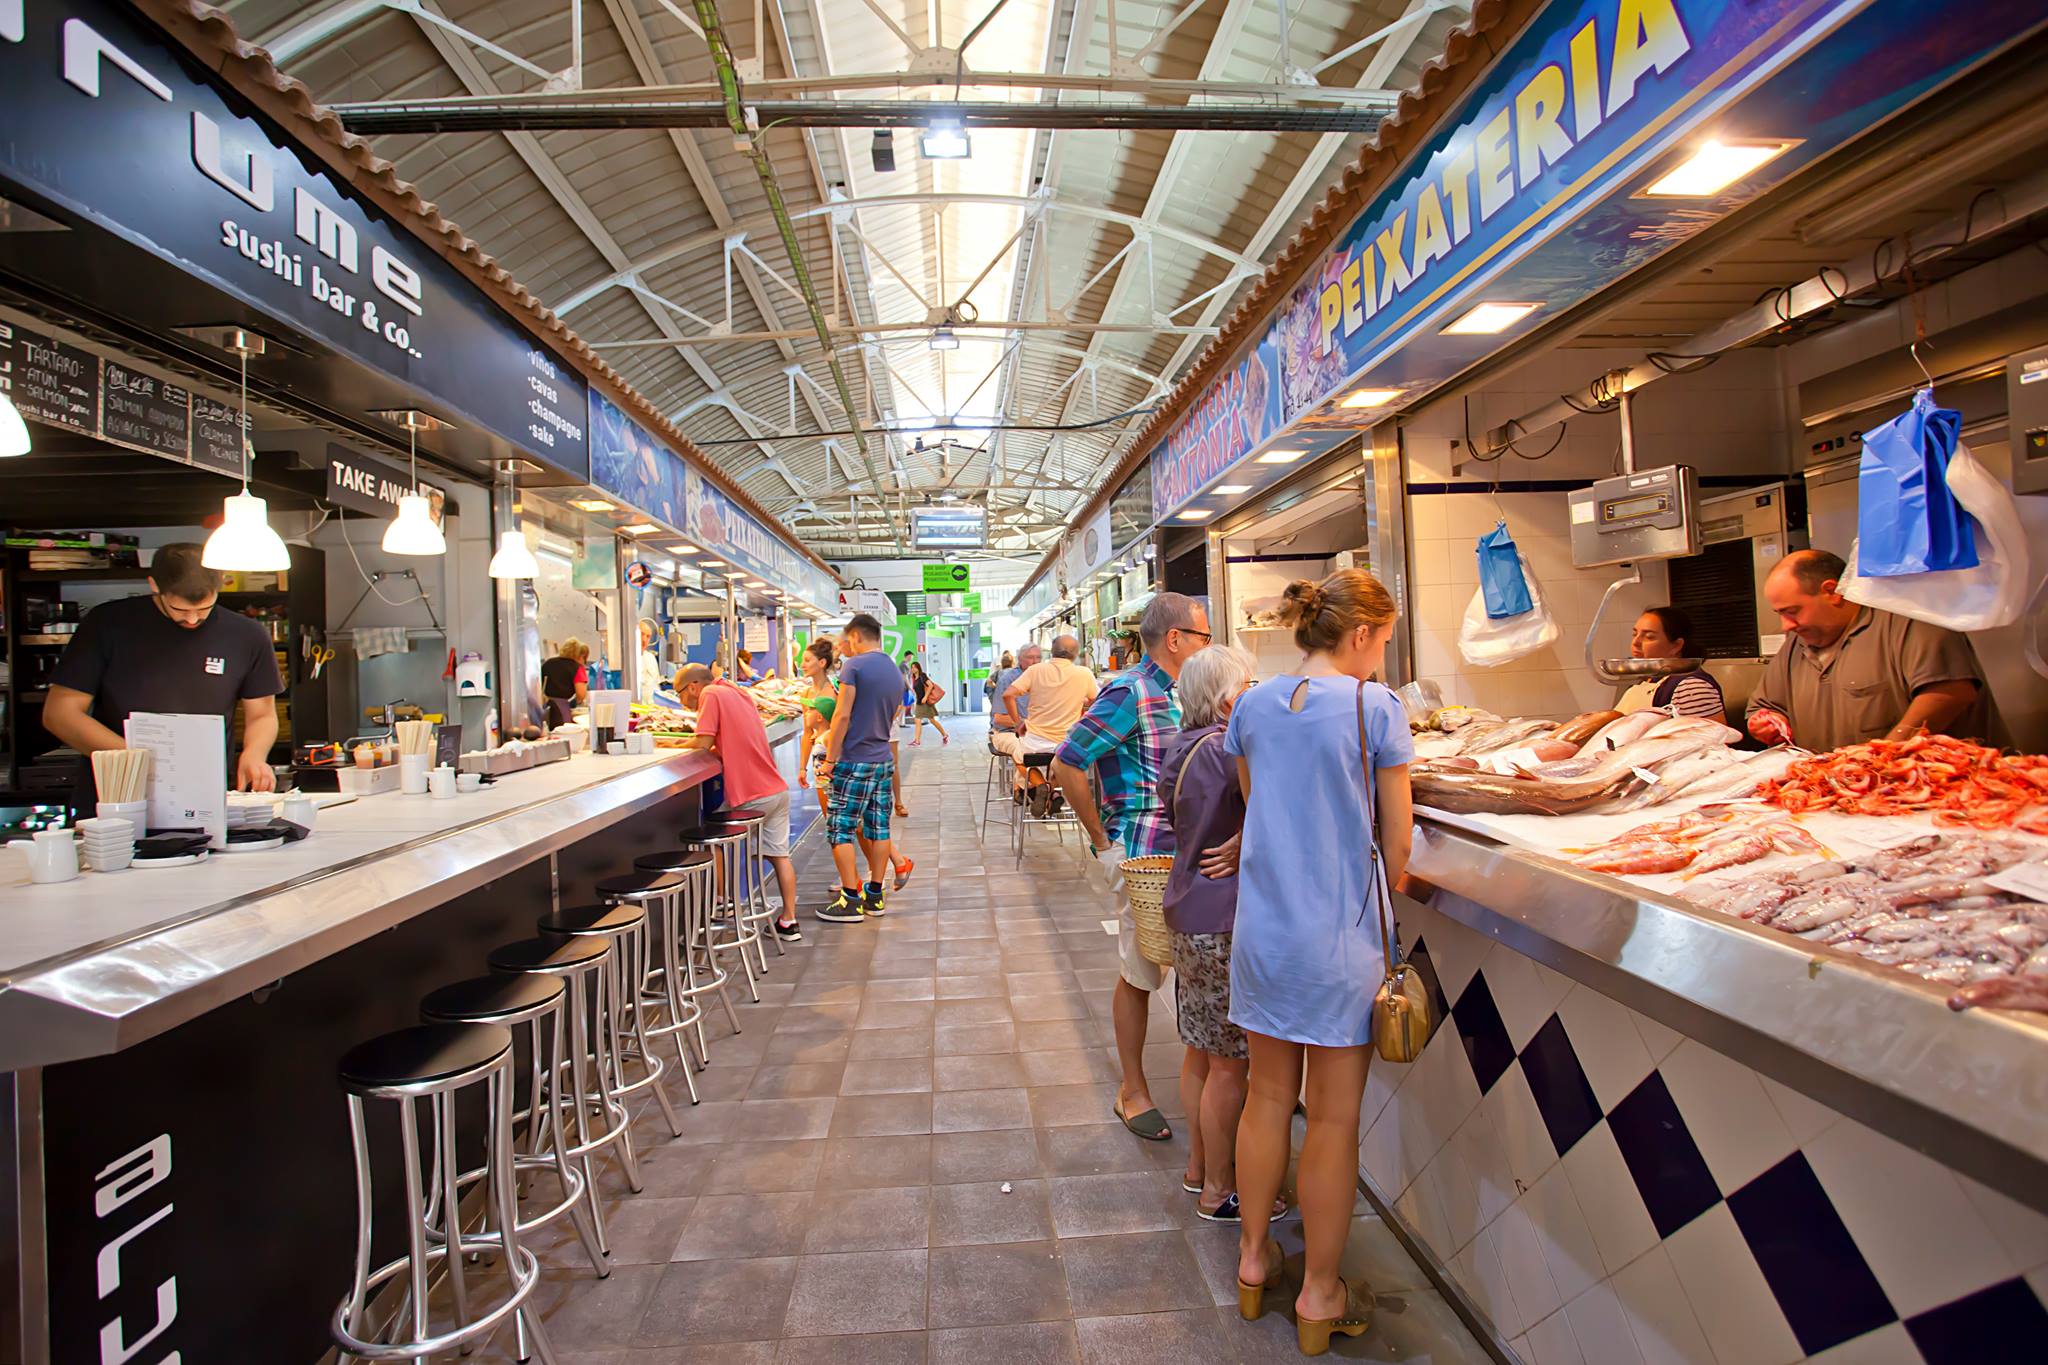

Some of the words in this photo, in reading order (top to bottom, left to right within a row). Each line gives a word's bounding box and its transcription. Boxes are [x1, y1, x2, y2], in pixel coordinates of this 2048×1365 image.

[0, 0, 422, 317] rume
[1320, 0, 1691, 358] PEIXATERIA
[221, 220, 303, 287] sushi
[312, 265, 356, 317] bar
[362, 301, 380, 334] &
[531, 399, 582, 441] champagne
[532, 424, 555, 447] sake
[1169, 402, 1245, 507] ANTONIA
[332, 460, 376, 497] TAKE
